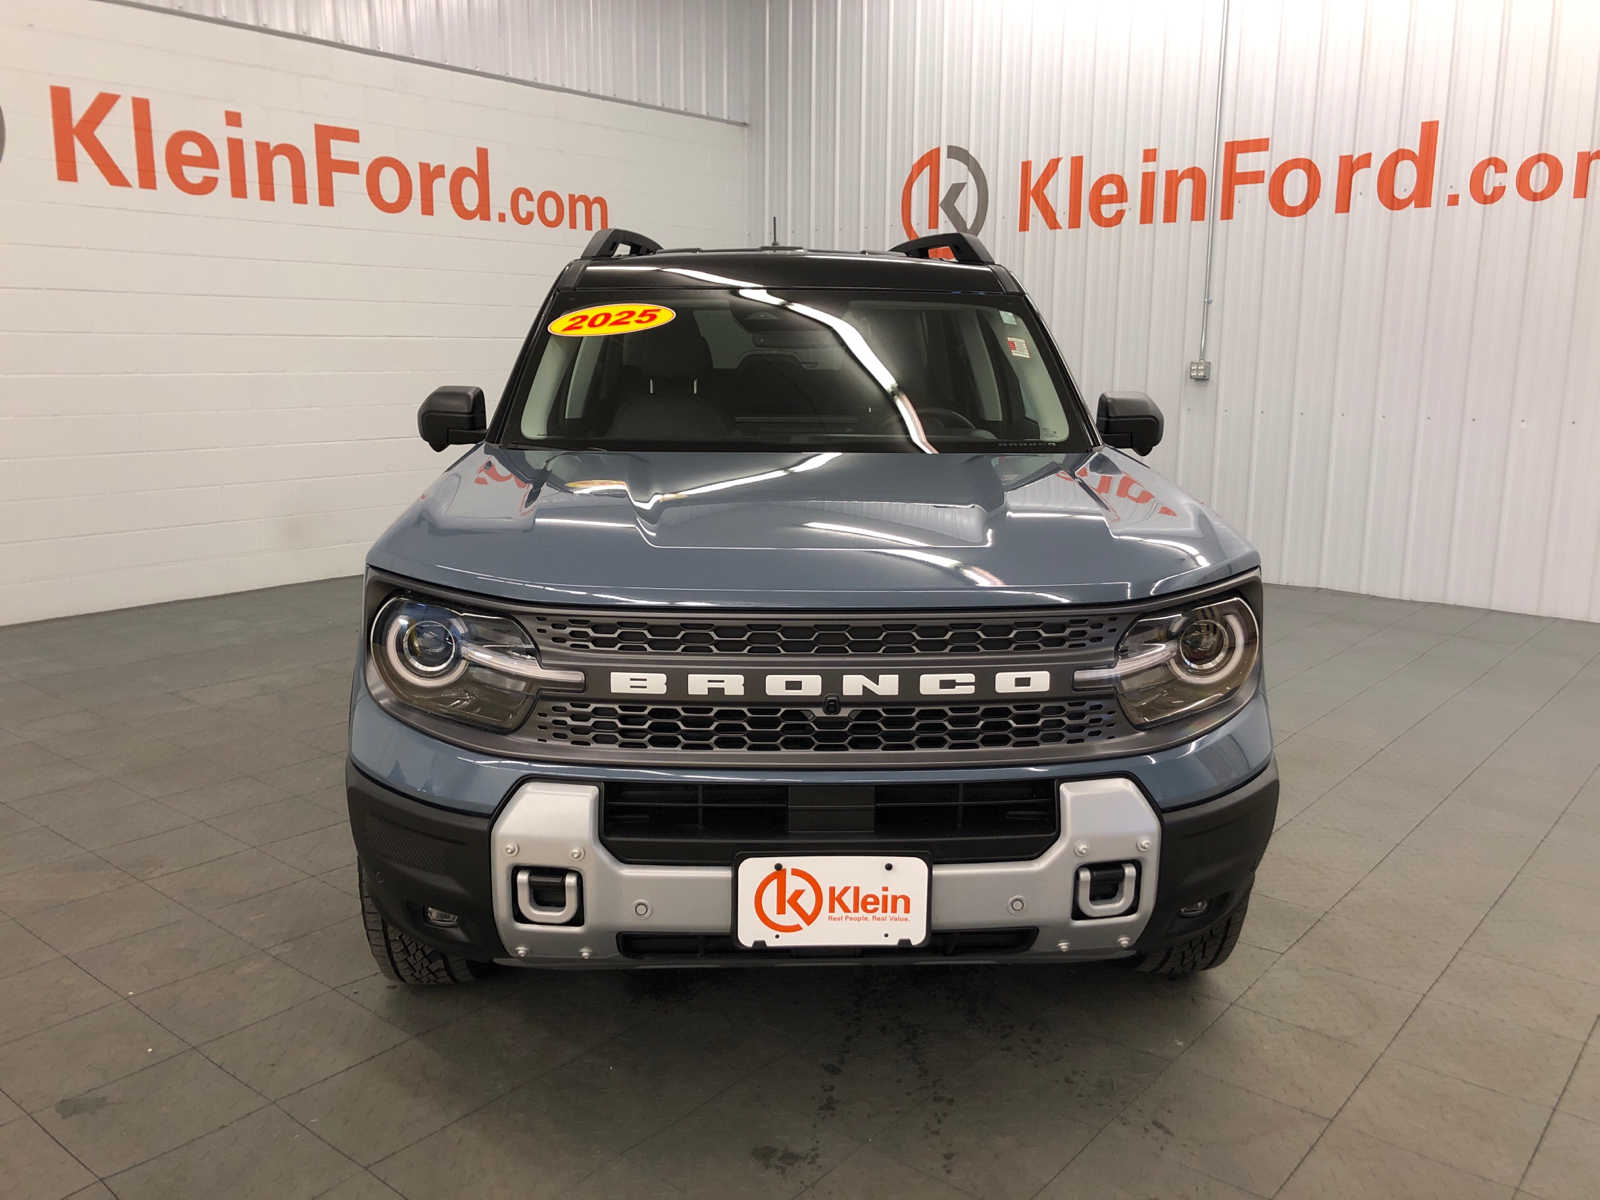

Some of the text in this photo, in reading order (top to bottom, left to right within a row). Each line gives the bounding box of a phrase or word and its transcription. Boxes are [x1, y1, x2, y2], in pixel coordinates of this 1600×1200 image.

[49, 84, 609, 232] KleinFord.com
[560, 308, 662, 332] 2025
[610, 671, 1051, 696] BRONCO
[828, 886, 911, 914] Klein
[844, 915, 870, 923] People.
